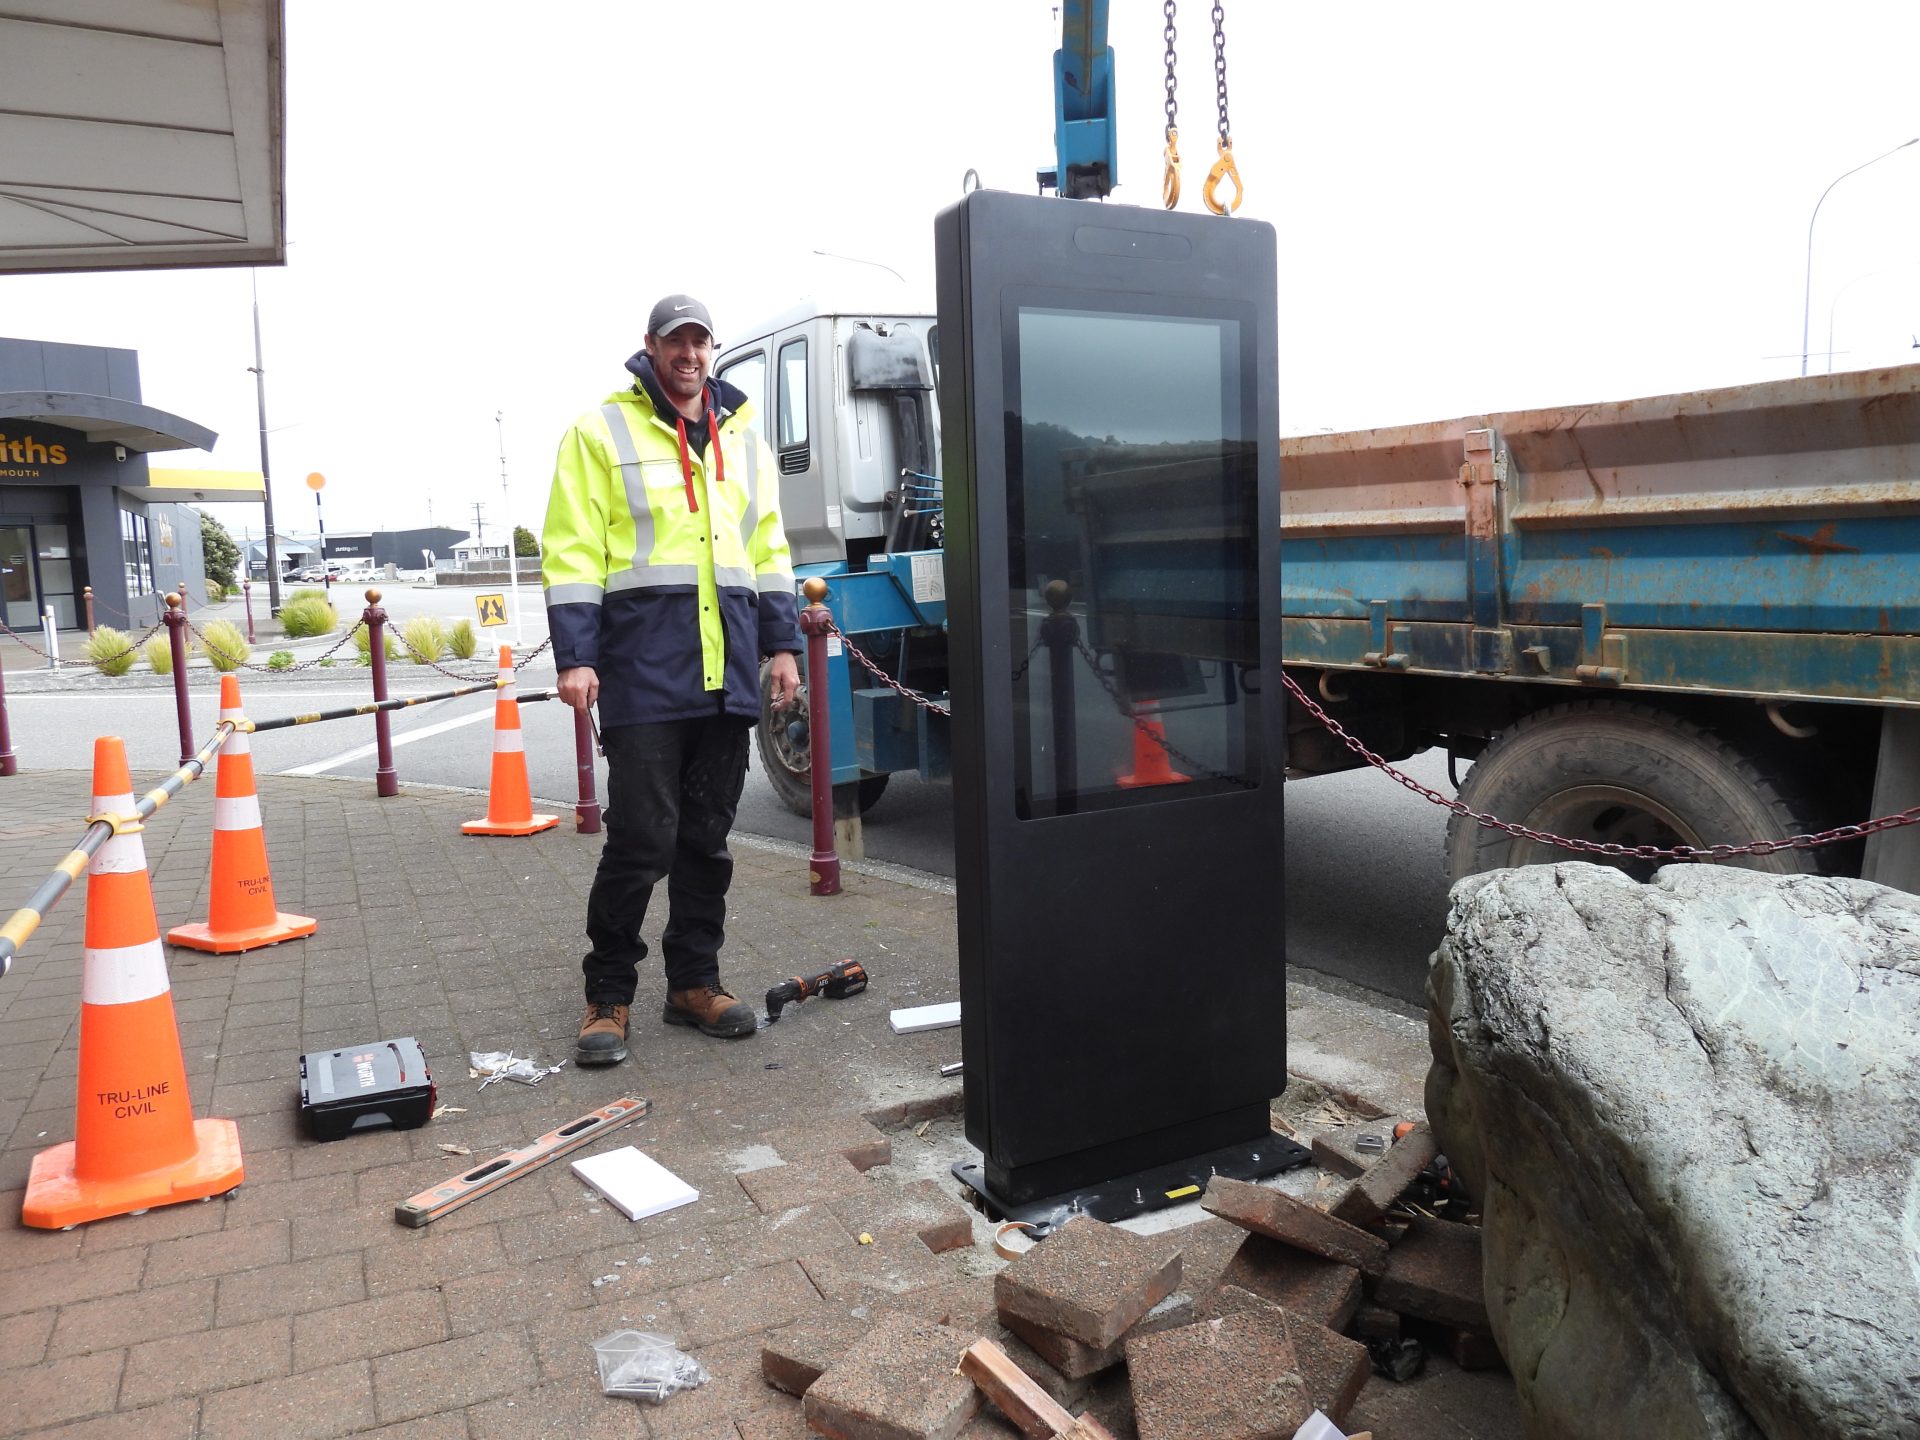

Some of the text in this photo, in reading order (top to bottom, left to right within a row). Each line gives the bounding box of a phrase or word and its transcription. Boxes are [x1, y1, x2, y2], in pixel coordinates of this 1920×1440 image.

[0, 433, 68, 465] iths
[248, 886, 268, 896] CIVIL
[97, 1082, 170, 1106] TRU-LINE
[115, 1102, 156, 1119] CIVIL
